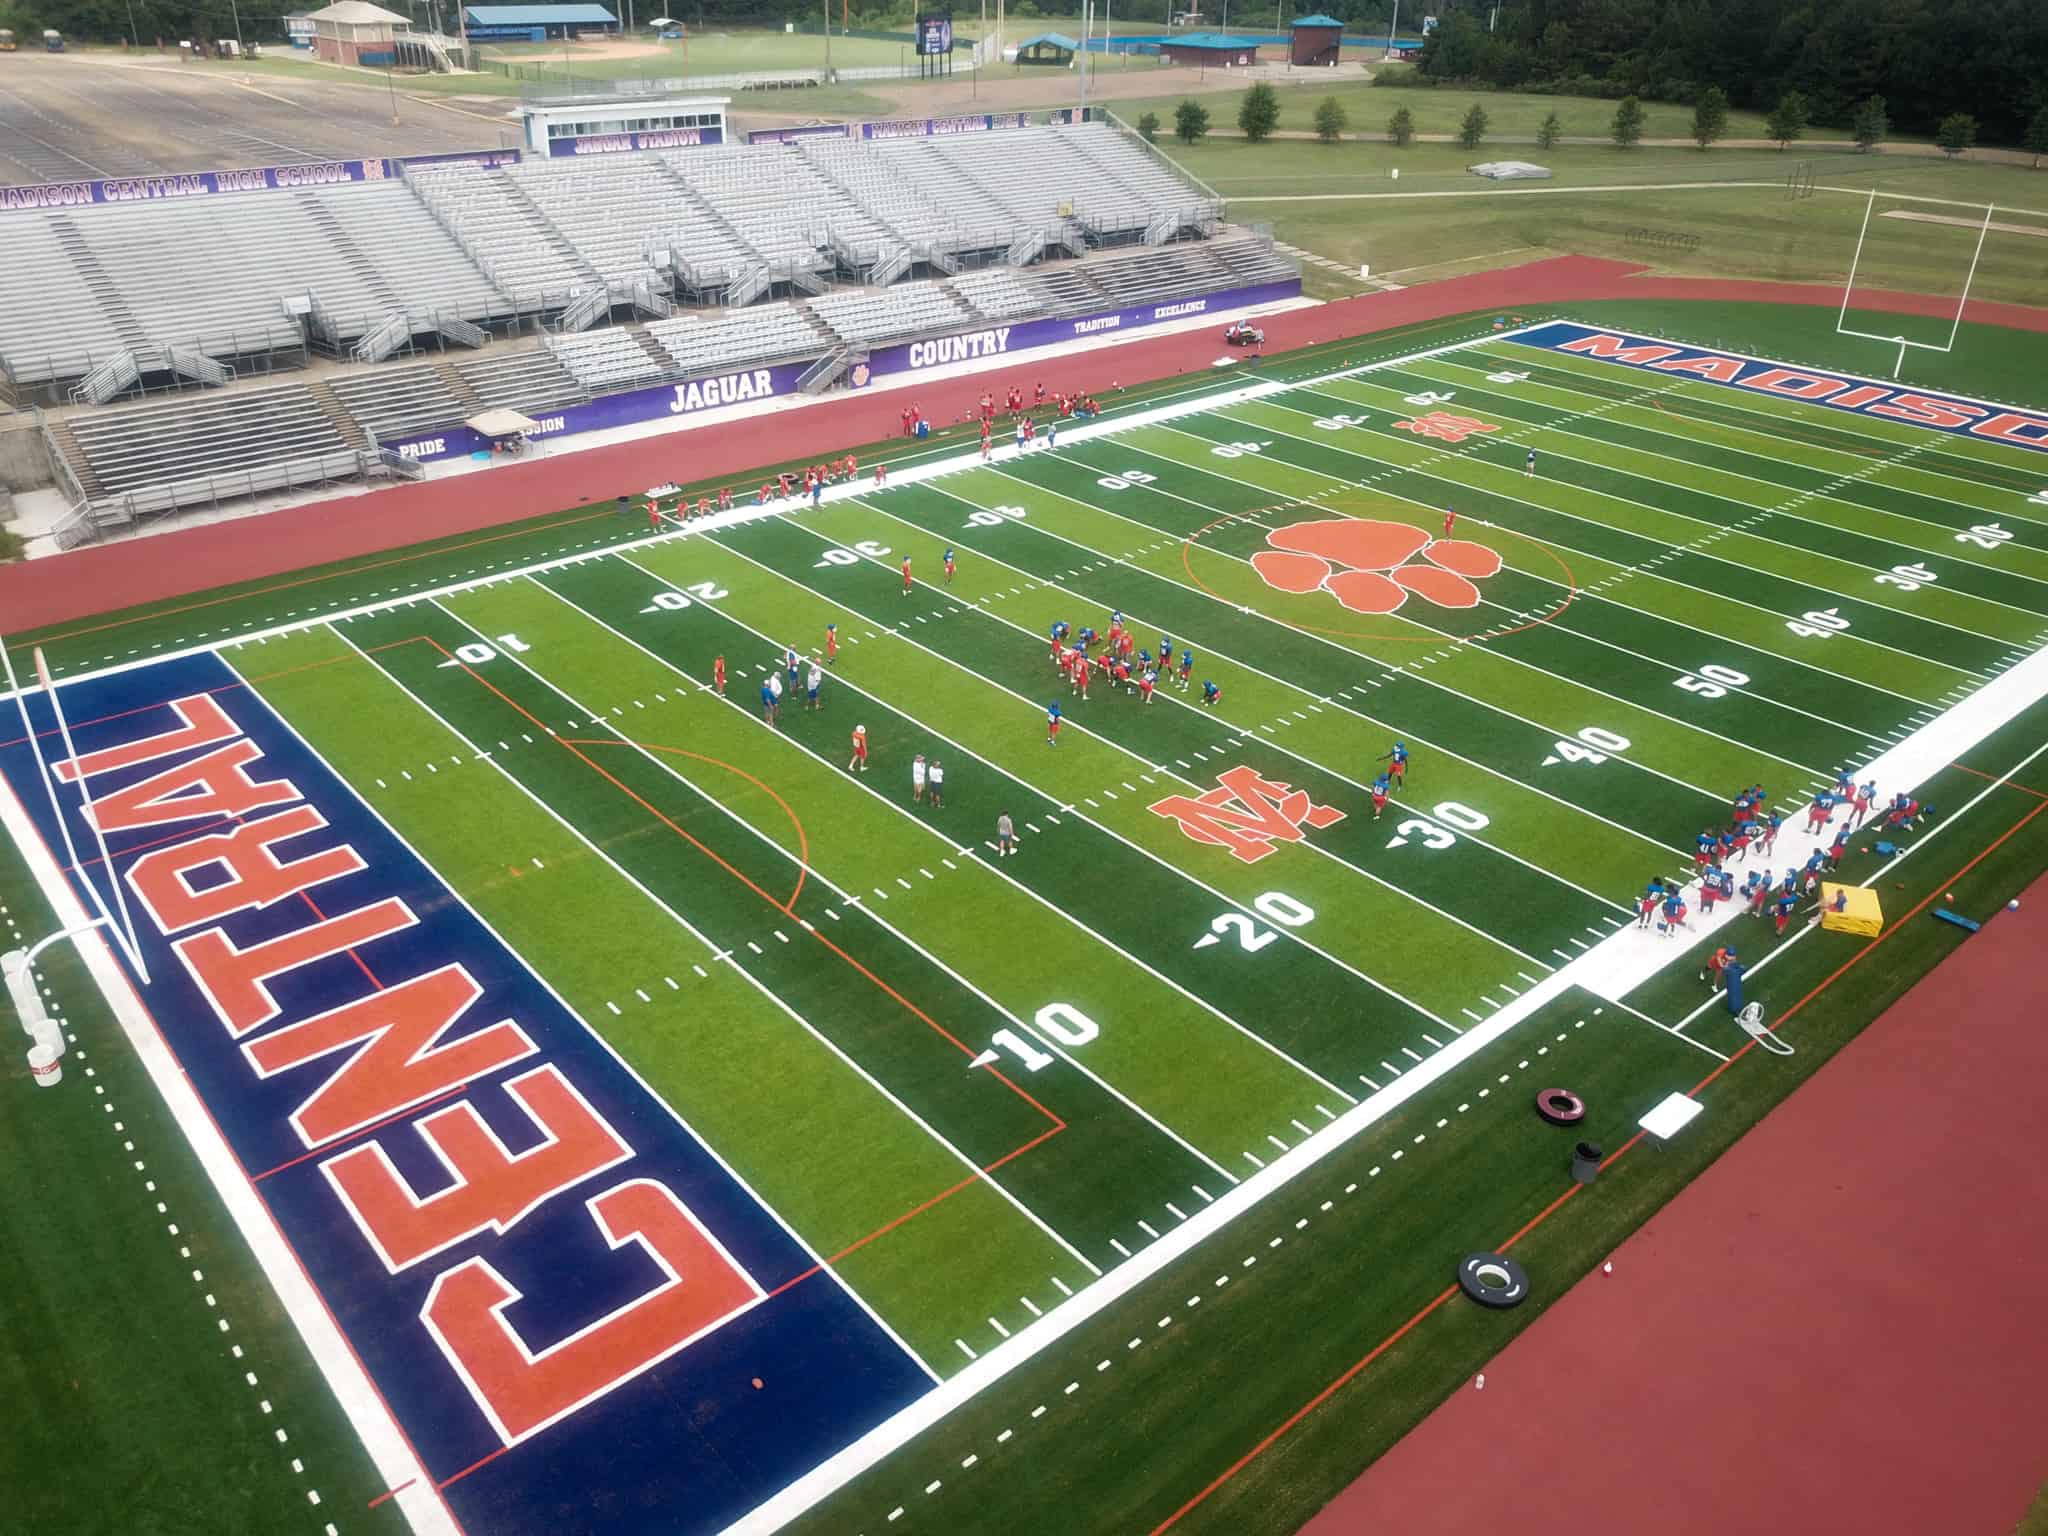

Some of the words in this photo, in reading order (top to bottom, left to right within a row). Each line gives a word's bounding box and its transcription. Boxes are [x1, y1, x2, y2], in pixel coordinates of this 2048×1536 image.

[103, 174, 208, 200] CENTRAL
[216, 169, 267, 192] HIGH
[275, 162, 351, 186] SCHOOL
[1074, 315, 1121, 335] TRADITION
[1154, 300, 1206, 319] EXCELLENCE
[910, 328, 1011, 368] COUNTRY
[669, 370, 774, 412] JAGUAR
[399, 437, 446, 460] PRIDE
[1097, 470, 1158, 490] 50
[968, 505, 1027, 527] 40
[821, 541, 891, 566] 30
[1955, 524, 2015, 549] 20
[1873, 564, 1938, 591] 30
[651, 582, 729, 610] 20
[1785, 610, 1852, 639] 40
[455, 633, 531, 663] 10
[1672, 664, 1751, 698] 50
[1553, 726, 1632, 764] 40
[1396, 801, 1490, 849] 30
[1211, 890, 1315, 952] 20
[991, 1002, 1099, 1073] 10
[50, 692, 769, 1449] CENTRAL
